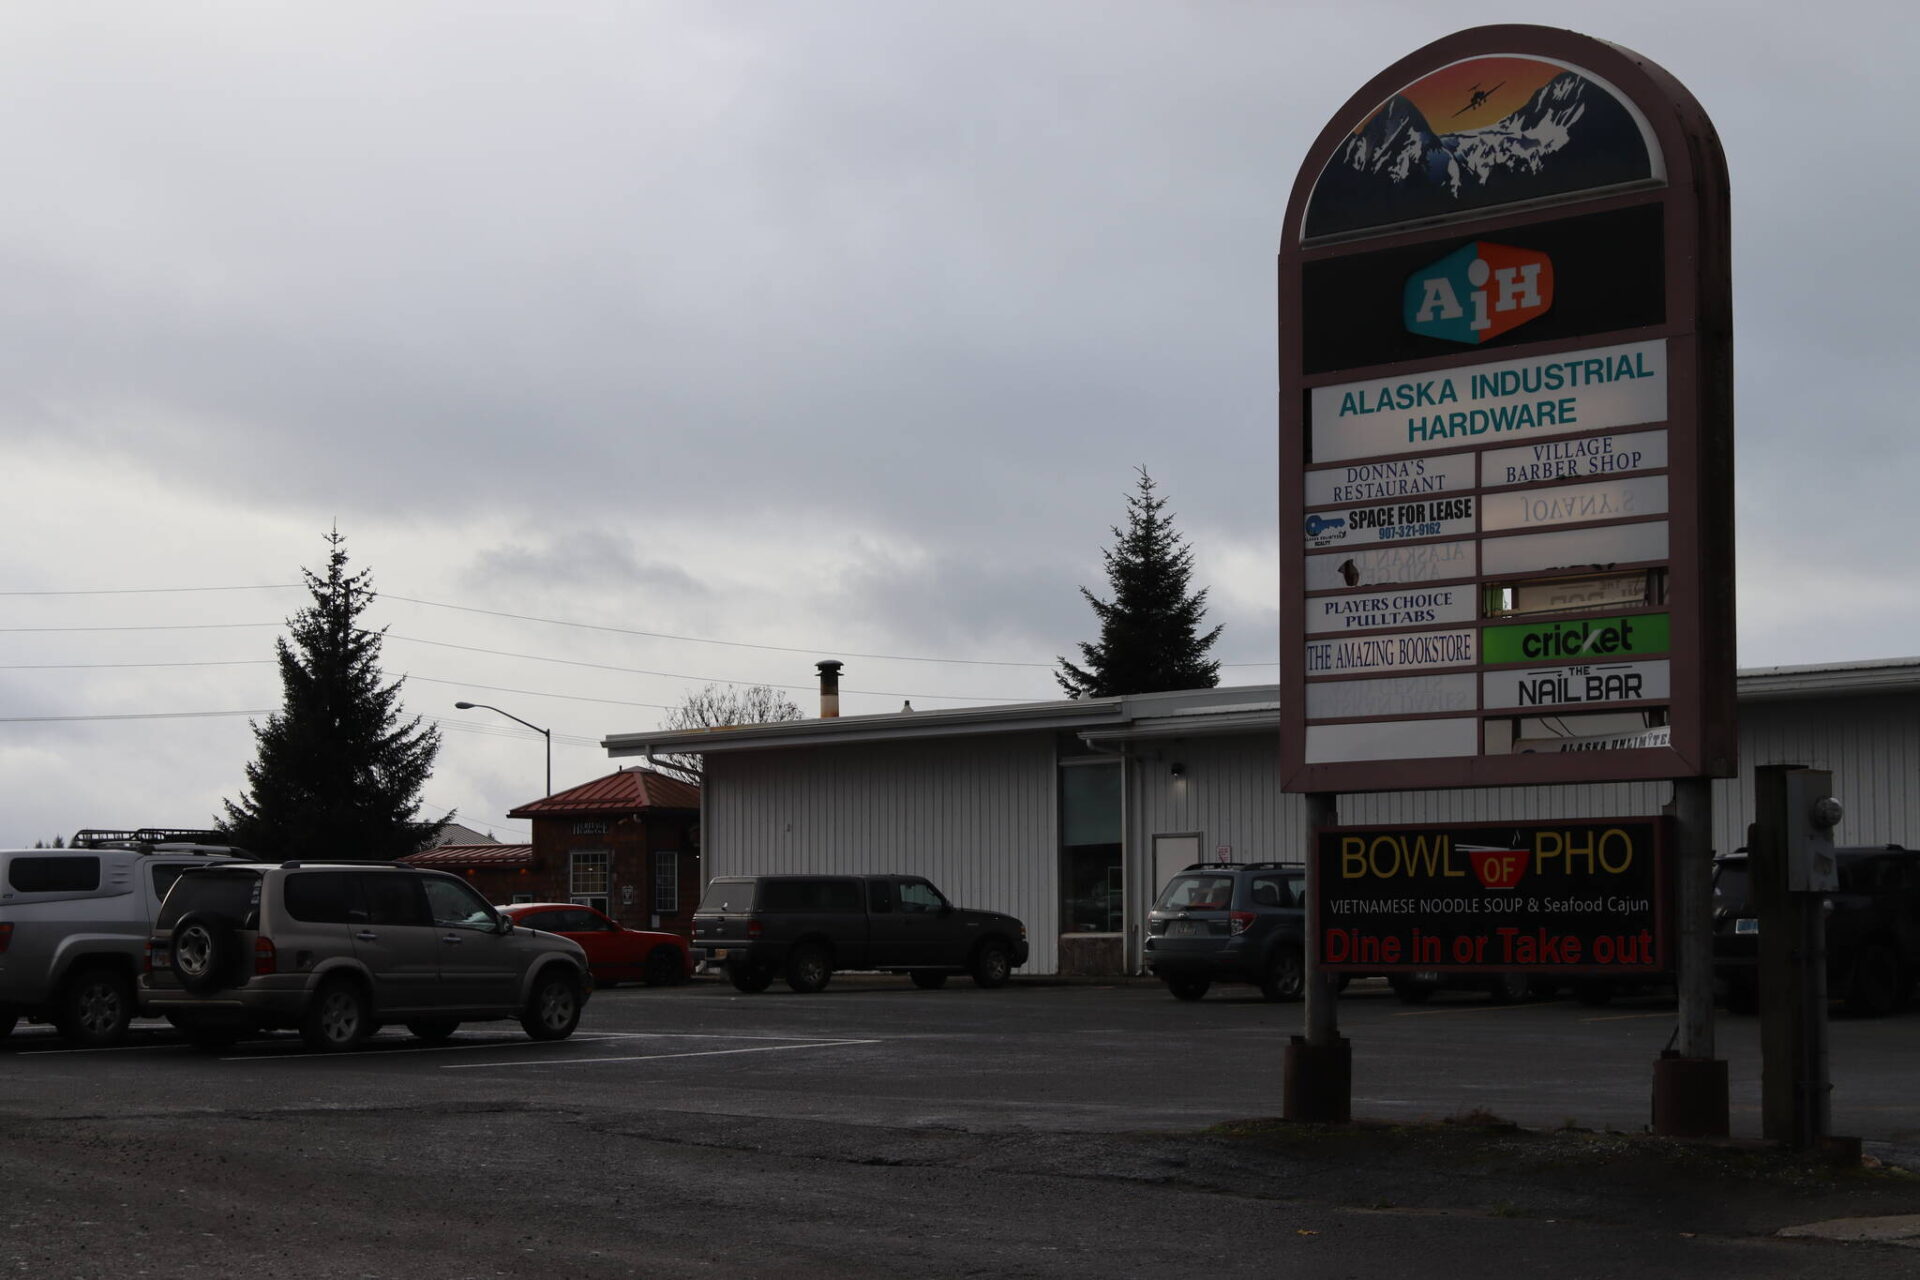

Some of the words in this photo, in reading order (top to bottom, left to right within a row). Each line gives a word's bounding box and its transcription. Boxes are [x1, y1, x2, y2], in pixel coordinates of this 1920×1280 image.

[1339, 378, 1457, 417] ALASKA
[1471, 352, 1655, 400] INDUSTRIAL
[1408, 397, 1577, 443] HARDWARE
[1534, 437, 1613, 461] VILLAGE
[1347, 459, 1425, 483] DONNA'S
[1506, 460, 1577, 483] BARBER
[1589, 451, 1642, 474] SHOP
[1333, 475, 1446, 502] RESTAURANT
[1349, 506, 1395, 530] SPACE
[1398, 503, 1426, 525] FOR
[1430, 498, 1472, 521] LEASE
[1379, 522, 1441, 540] 907-321-9162
[1324, 597, 1389, 615] PLAYERS
[1392, 592, 1453, 609] CHOICE
[1345, 609, 1436, 628] PULLTABS
[1307, 643, 1332, 671] THE
[1335, 639, 1394, 670] AMAZING
[1398, 634, 1472, 665] BOOKSTORE
[1522, 618, 1633, 659] cricket
[1568, 666, 1591, 676] THE
[1585, 673, 1643, 701] BAR
[1340, 834, 1466, 880] BOWL
[1482, 857, 1516, 883] OF
[1535, 828, 1634, 876] PHO
[1329, 897, 1416, 915] VIETNAMESE
[1419, 897, 1480, 914] NOODLE
[1484, 897, 1523, 914] SOUP
[1527, 897, 1540, 913] &
[1543, 895, 1603, 913] Seafood
[1607, 895, 1649, 916] Cajun
[1326, 928, 1402, 964] Dine
[1412, 927, 1442, 963] in
[1452, 933, 1489, 963] or
[1494, 926, 1582, 964] Take
[1592, 928, 1655, 964] out
